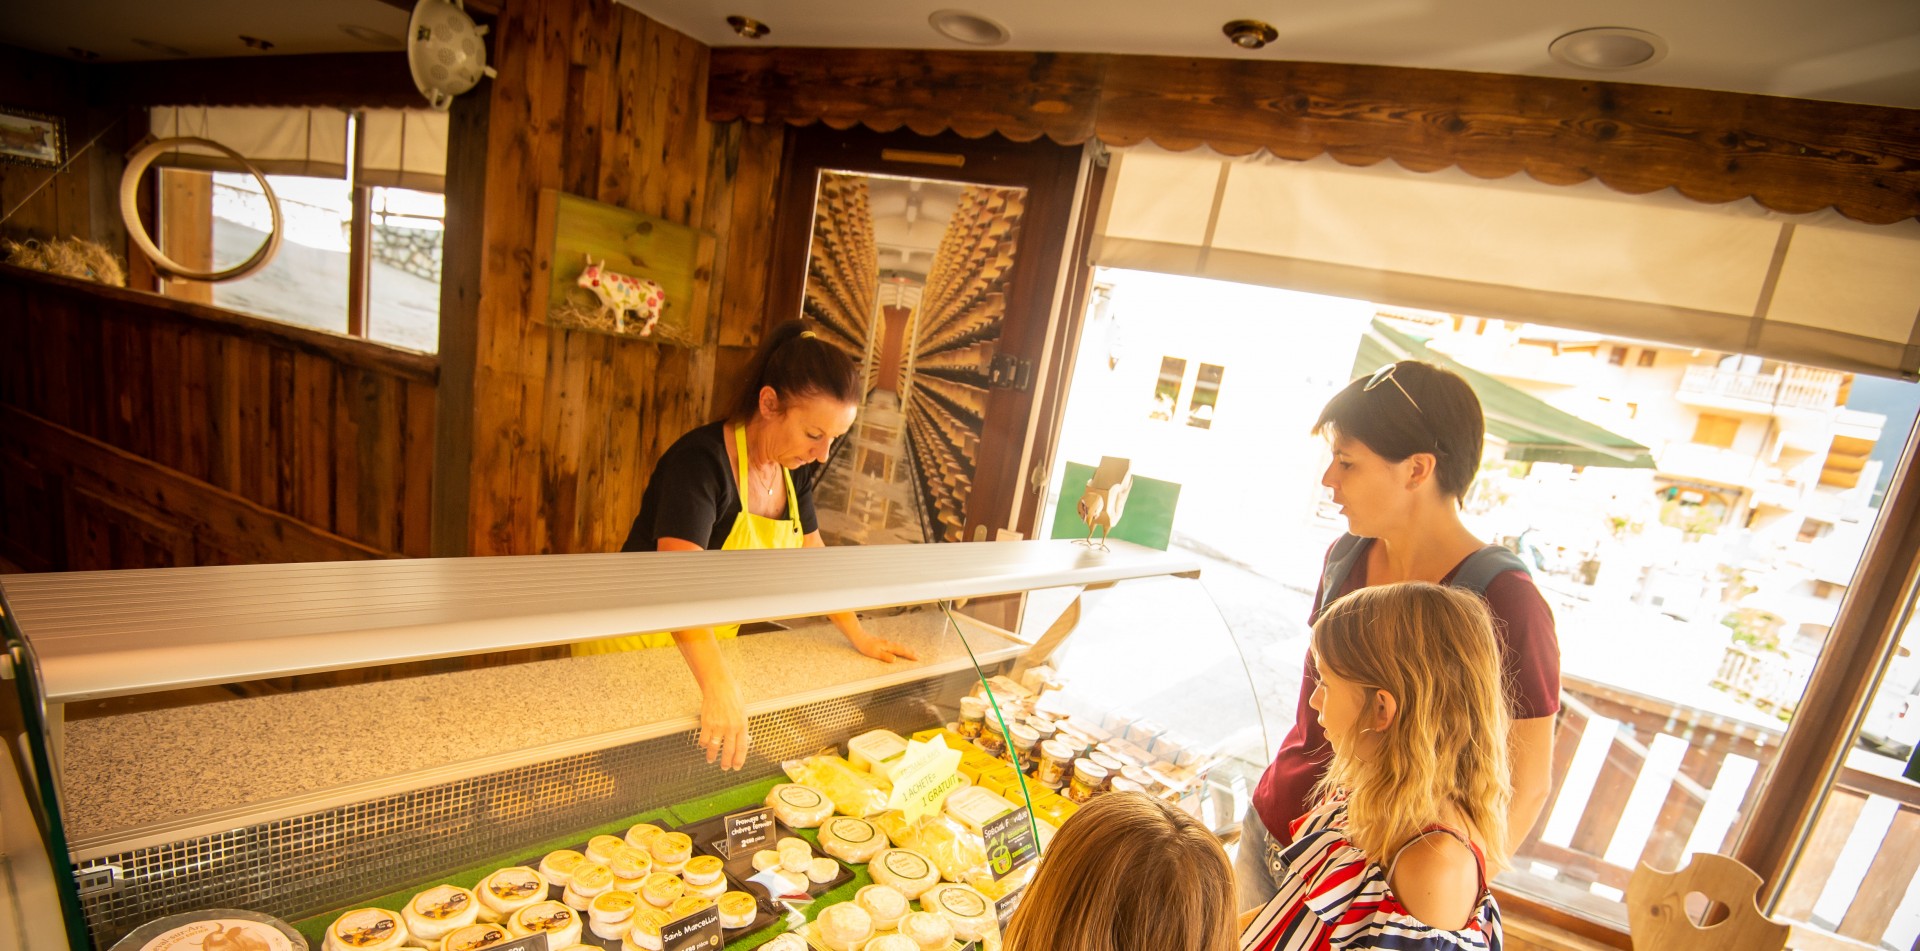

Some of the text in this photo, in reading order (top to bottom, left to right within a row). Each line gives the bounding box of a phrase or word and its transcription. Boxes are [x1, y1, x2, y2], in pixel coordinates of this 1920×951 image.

[902, 792, 908, 802] 1
[921, 797, 928, 807] 1
[928, 774, 957, 802] GRATUIT
[735, 816, 759, 827] Fromage
[984, 821, 1005, 839] Spécial
[664, 914, 717, 943] Saint Marcellin
